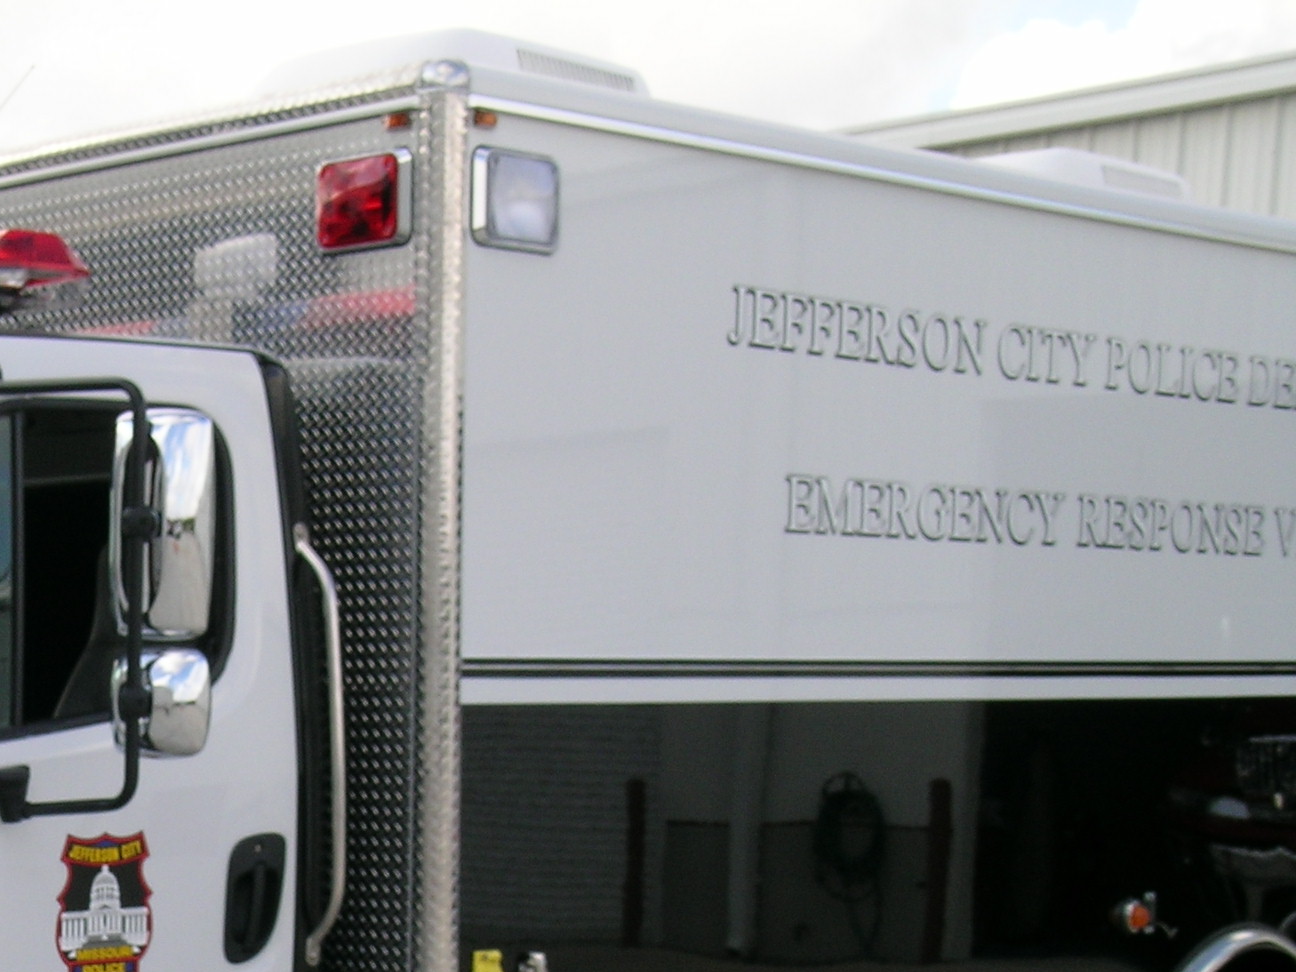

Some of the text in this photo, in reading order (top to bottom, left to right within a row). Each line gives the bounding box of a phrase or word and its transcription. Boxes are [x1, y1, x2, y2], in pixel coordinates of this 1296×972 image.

[727, 285, 987, 376] JEFFERSON
[997, 324, 1098, 388] CITY
[1104, 337, 1238, 405] POLICE
[784, 474, 1066, 548] EMERGENCY
[1075, 492, 1265, 557] RESPONSE
